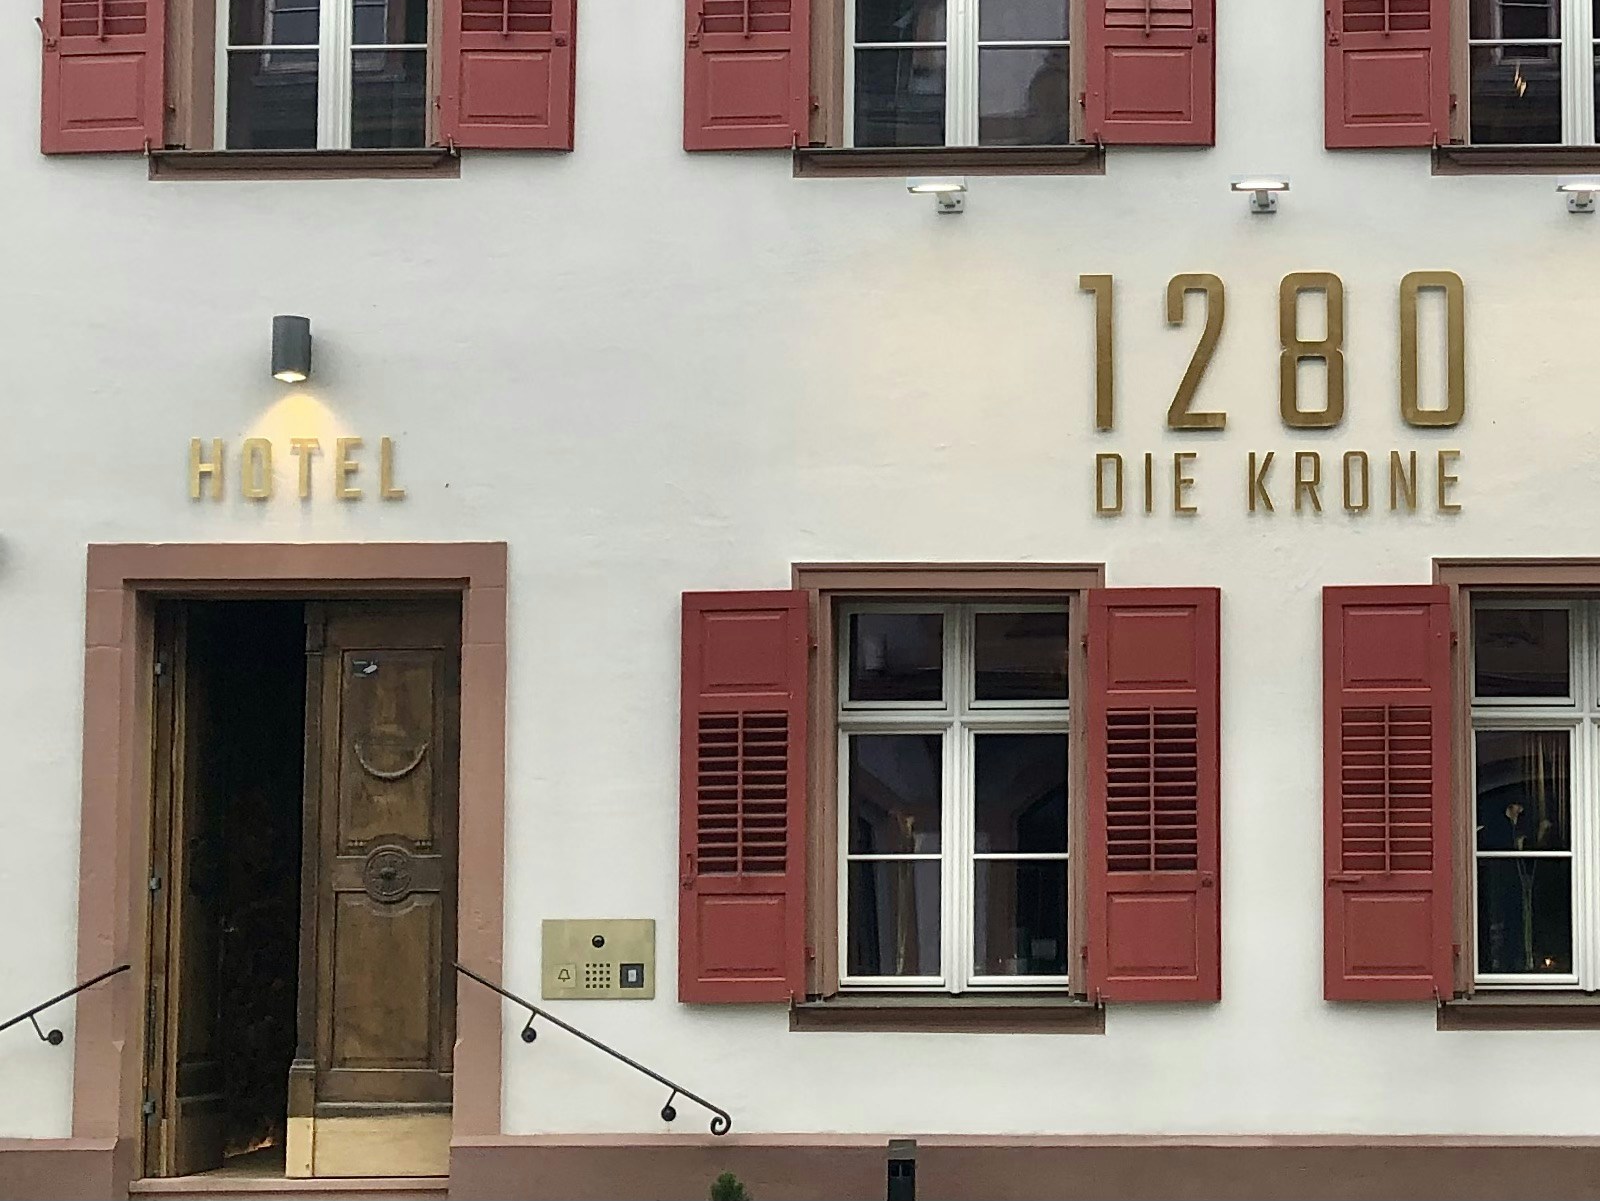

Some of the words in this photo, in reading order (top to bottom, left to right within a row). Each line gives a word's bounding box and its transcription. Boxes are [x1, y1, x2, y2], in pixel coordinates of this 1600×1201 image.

[1079, 270, 1466, 430] 1280
[189, 436, 406, 500] HOTEL
[1095, 451, 1199, 515] DIE
[1247, 449, 1463, 513] KRONE
